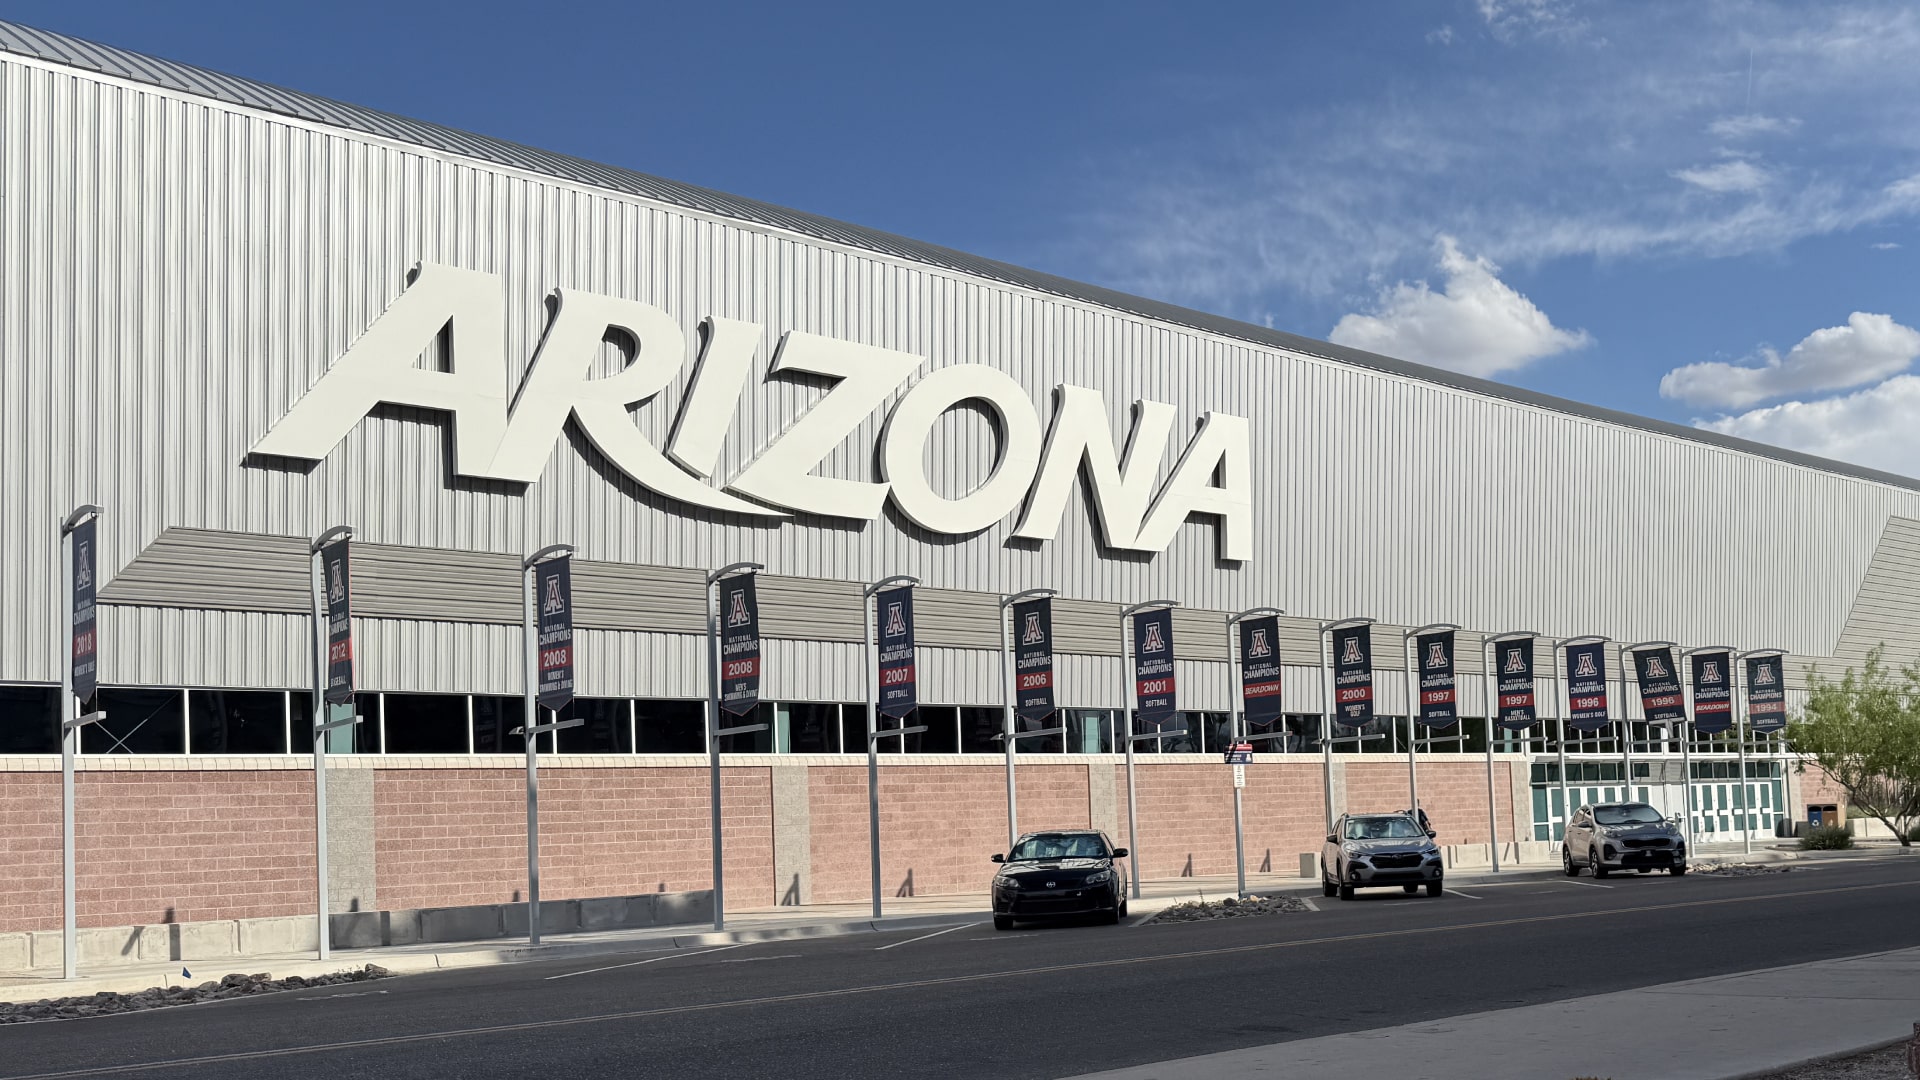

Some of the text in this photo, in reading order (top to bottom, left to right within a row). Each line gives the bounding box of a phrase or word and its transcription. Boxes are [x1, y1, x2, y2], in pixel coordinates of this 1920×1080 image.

[247, 263, 1252, 561] ARIZONA
[544, 574, 564, 616] A
[728, 589, 750, 628] A
[74, 606, 94, 625] CHAMPIONS
[886, 602, 906, 638] A
[1023, 612, 1044, 645] A
[540, 629, 571, 645] CHAMPIONS
[1143, 622, 1165, 654] A
[1249, 629, 1271, 658] A
[77, 634, 91, 654] 2018
[724, 640, 758, 655] CHAMPIONS
[1342, 637, 1363, 664] A
[332, 644, 345, 660] 2012
[545, 650, 566, 667] 2008
[881, 649, 912, 662] CHAMPIONS
[1426, 642, 1448, 669] A
[1018, 656, 1051, 669] CHAMPIONS
[1504, 648, 1526, 673] A
[1575, 653, 1597, 677] A
[729, 661, 752, 676] 2008
[1138, 664, 1172, 675] CHAMPIONS
[1244, 667, 1279, 679] CHAMPIONS
[1646, 657, 1668, 678] A
[1701, 662, 1721, 684] A
[331, 675, 346, 687] BASEBALL
[886, 669, 908, 683] 2007
[1024, 674, 1046, 686] 2006
[1337, 674, 1370, 684] CHAMPIONS
[1755, 664, 1775, 685] A
[1144, 681, 1166, 693] 2001
[1422, 677, 1455, 687] CHAMPIONS
[1500, 683, 1533, 691] CHAMPIONS
[888, 689, 908, 699] SOFTBALL
[1342, 689, 1365, 699] 2000
[1571, 685, 1604, 694] CHAMPIONS
[1643, 685, 1678, 694] CHAMPIONS
[1695, 691, 1729, 699] CHAMPIONS
[1750, 692, 1782, 700] CHAMPIONS
[1025, 698, 1047, 706] SOFTBALL
[1146, 699, 1167, 707] SOFTBALL
[1428, 692, 1449, 701] 1997
[1506, 696, 1527, 705] 1997
[1577, 698, 1599, 707] 1996
[1345, 704, 1365, 712] WOMEN'S
[1756, 704, 1777, 712] 1994
